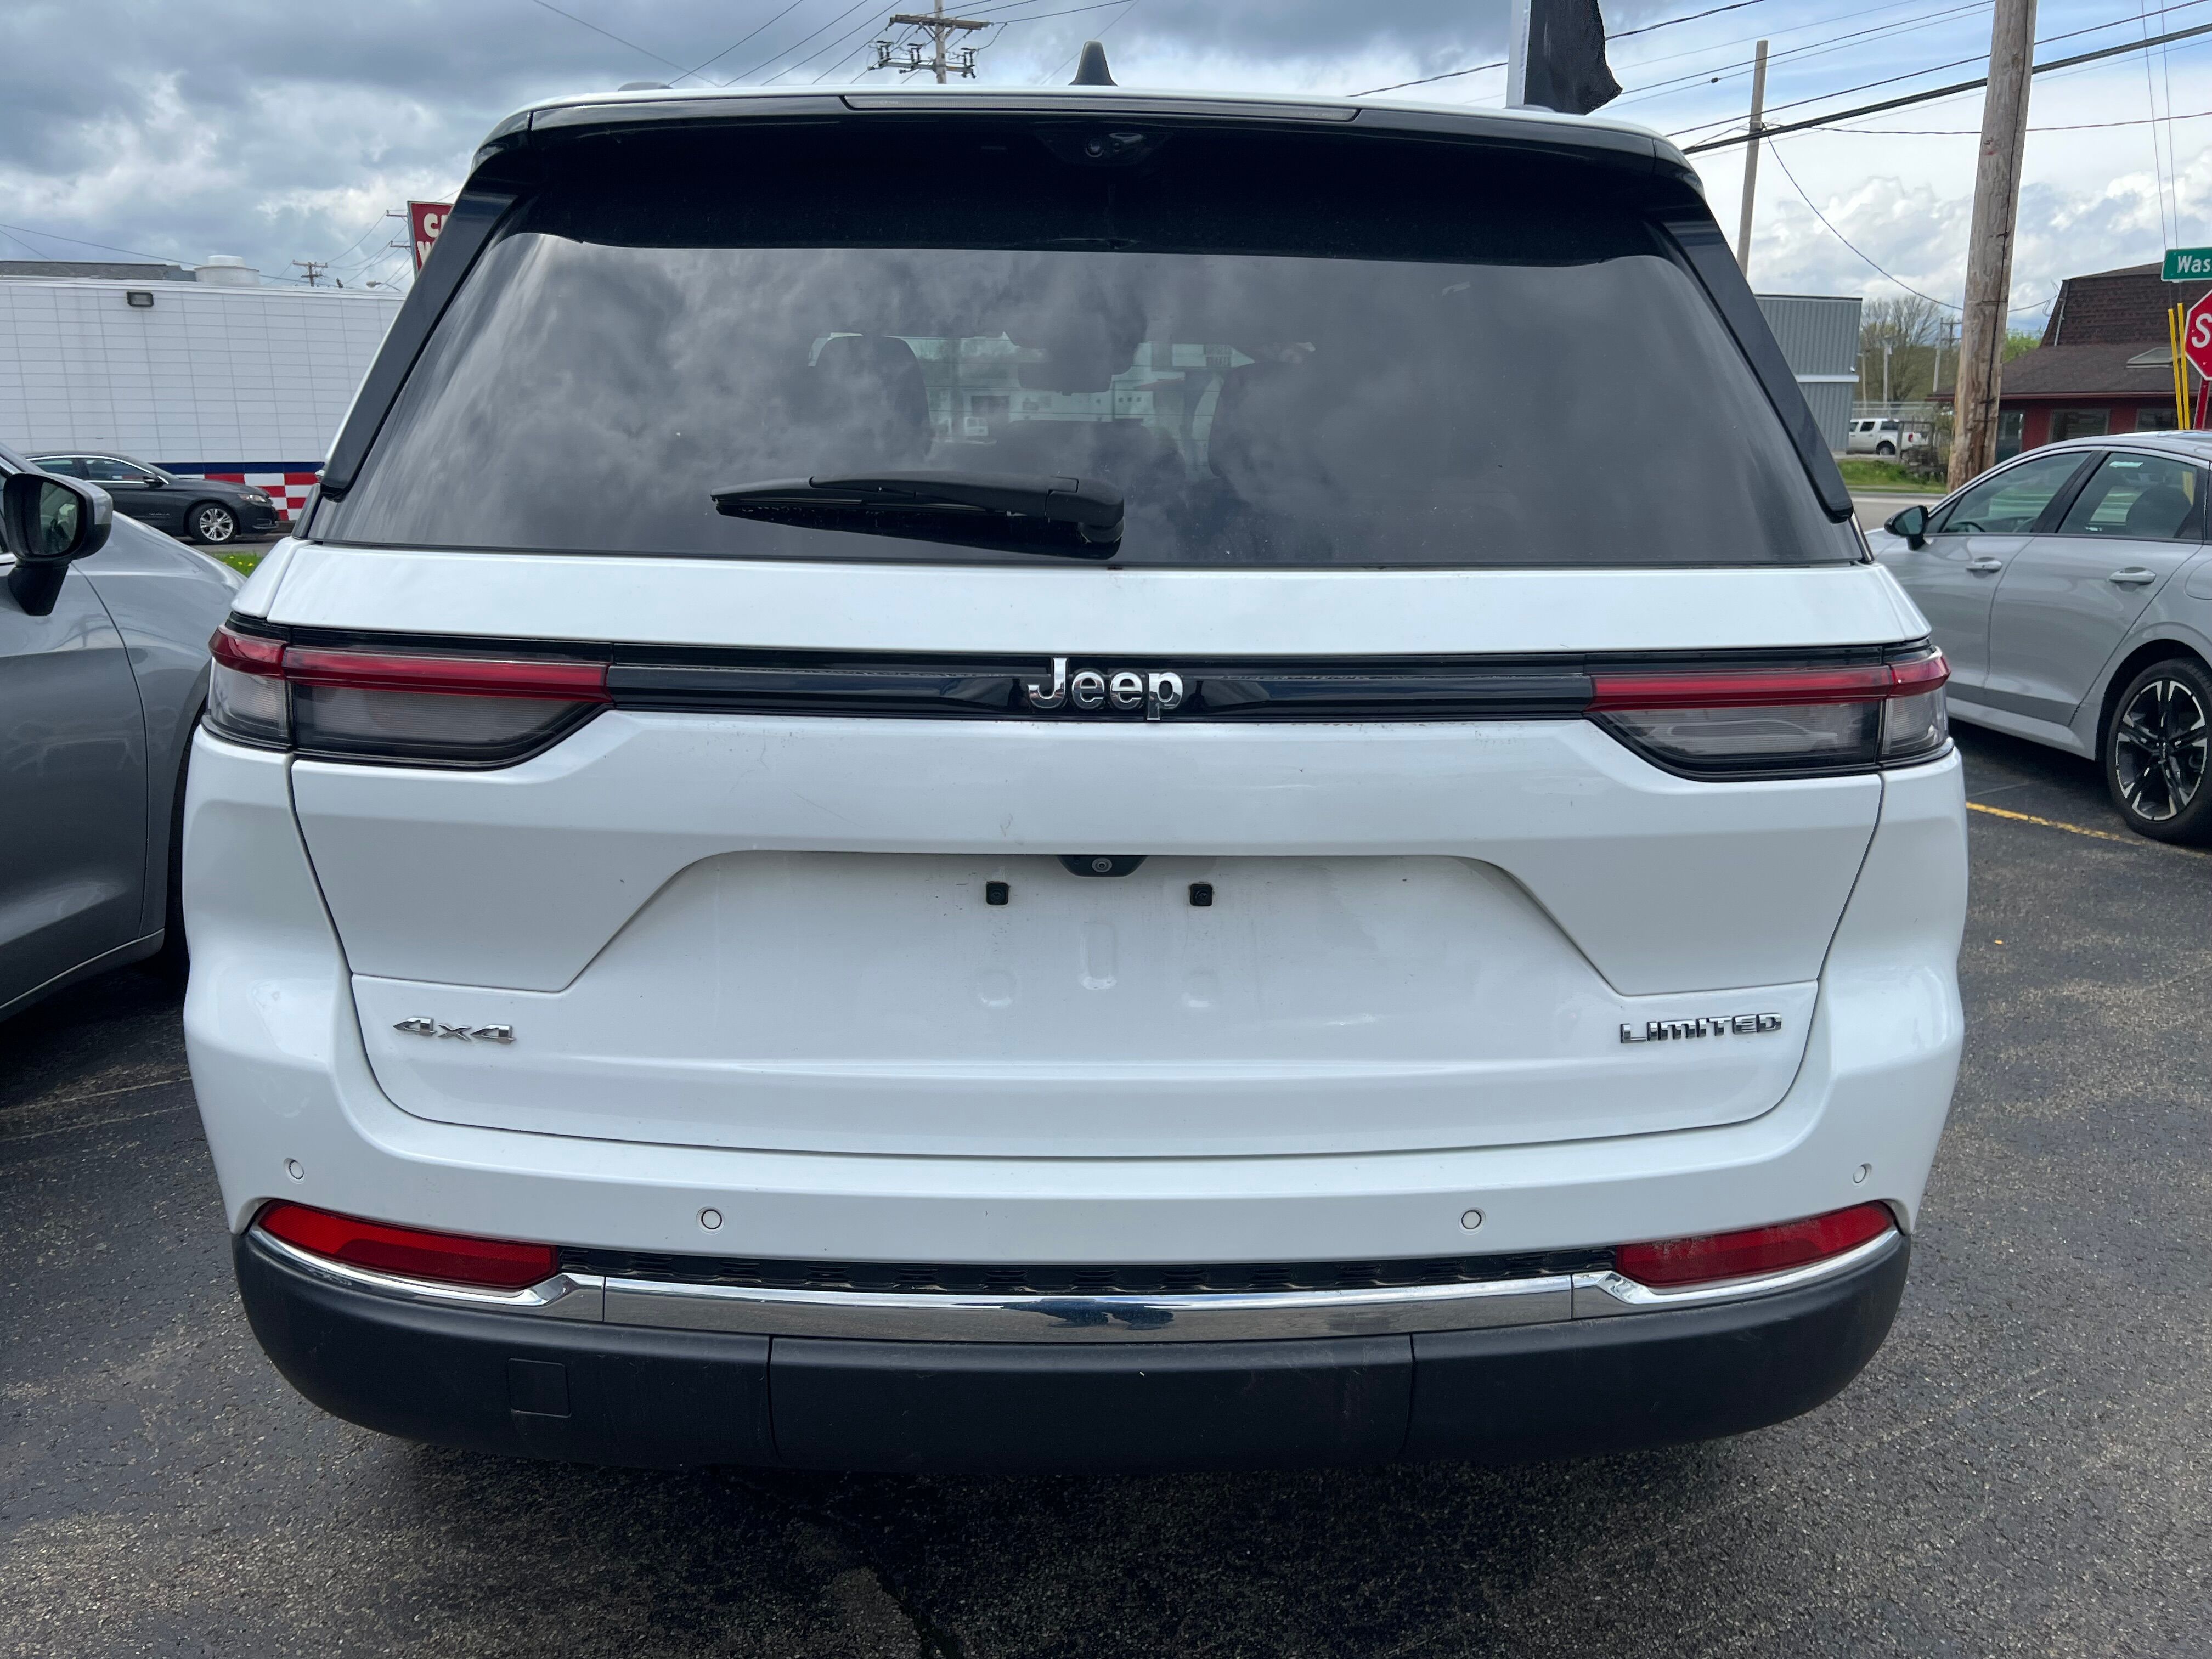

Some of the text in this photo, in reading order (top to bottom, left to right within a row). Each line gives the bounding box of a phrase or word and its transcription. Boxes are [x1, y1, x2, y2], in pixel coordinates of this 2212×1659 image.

[2177, 255, 2212, 273] Was
[1028, 658, 1183, 721] Jeep
[1620, 1013, 1782, 1043] LIMITED
